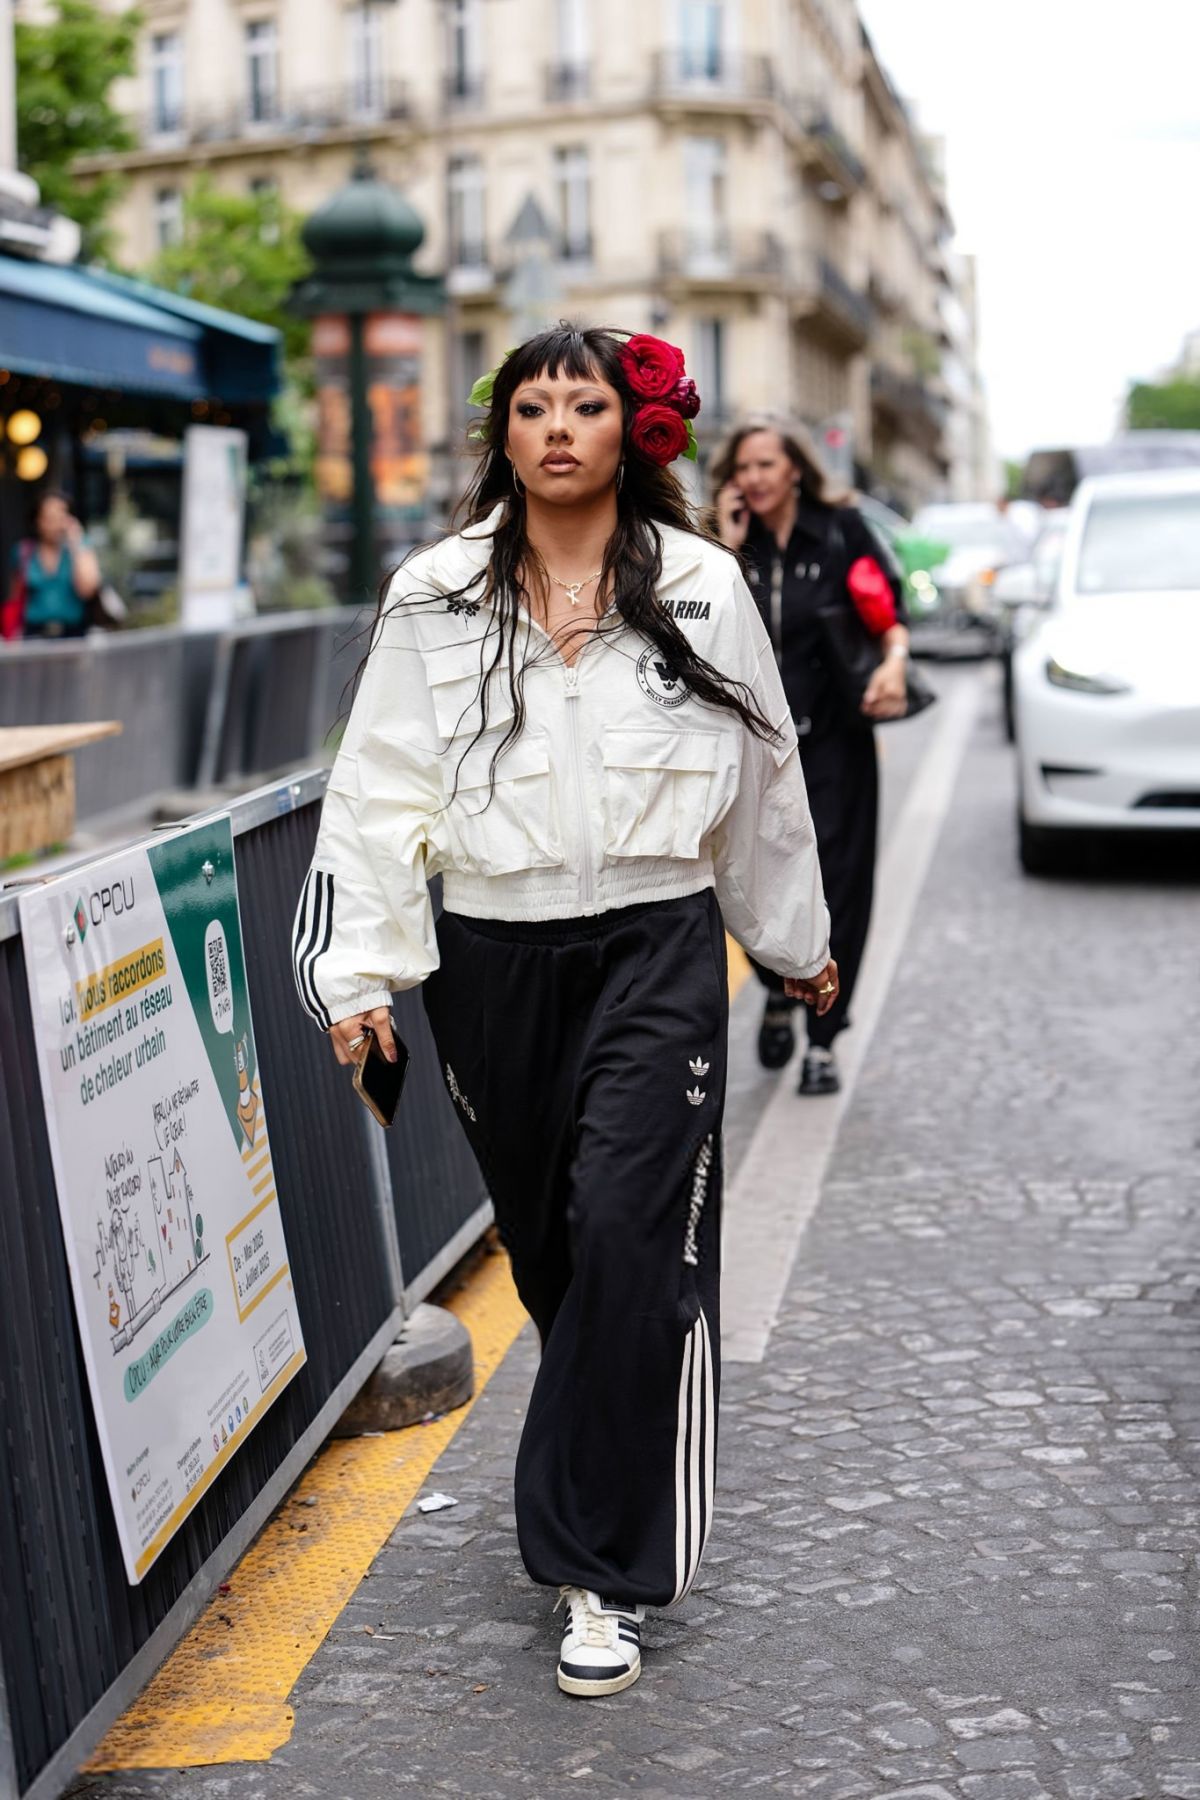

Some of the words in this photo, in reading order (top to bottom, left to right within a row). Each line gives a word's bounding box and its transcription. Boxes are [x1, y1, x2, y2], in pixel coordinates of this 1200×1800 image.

[646, 688, 662, 702] WILLY
[90, 877, 135, 927] CPCU
[79, 981, 107, 1015] nous
[107, 950, 164, 997] raccordons
[60, 1044, 76, 1072] un
[76, 1008, 124, 1062] bâtiment
[125, 1005, 139, 1031] au
[140, 984, 173, 1022] réseau
[80, 1074, 95, 1106] de
[94, 1050, 133, 1097] chaleur
[135, 1027, 166, 1068] urbain
